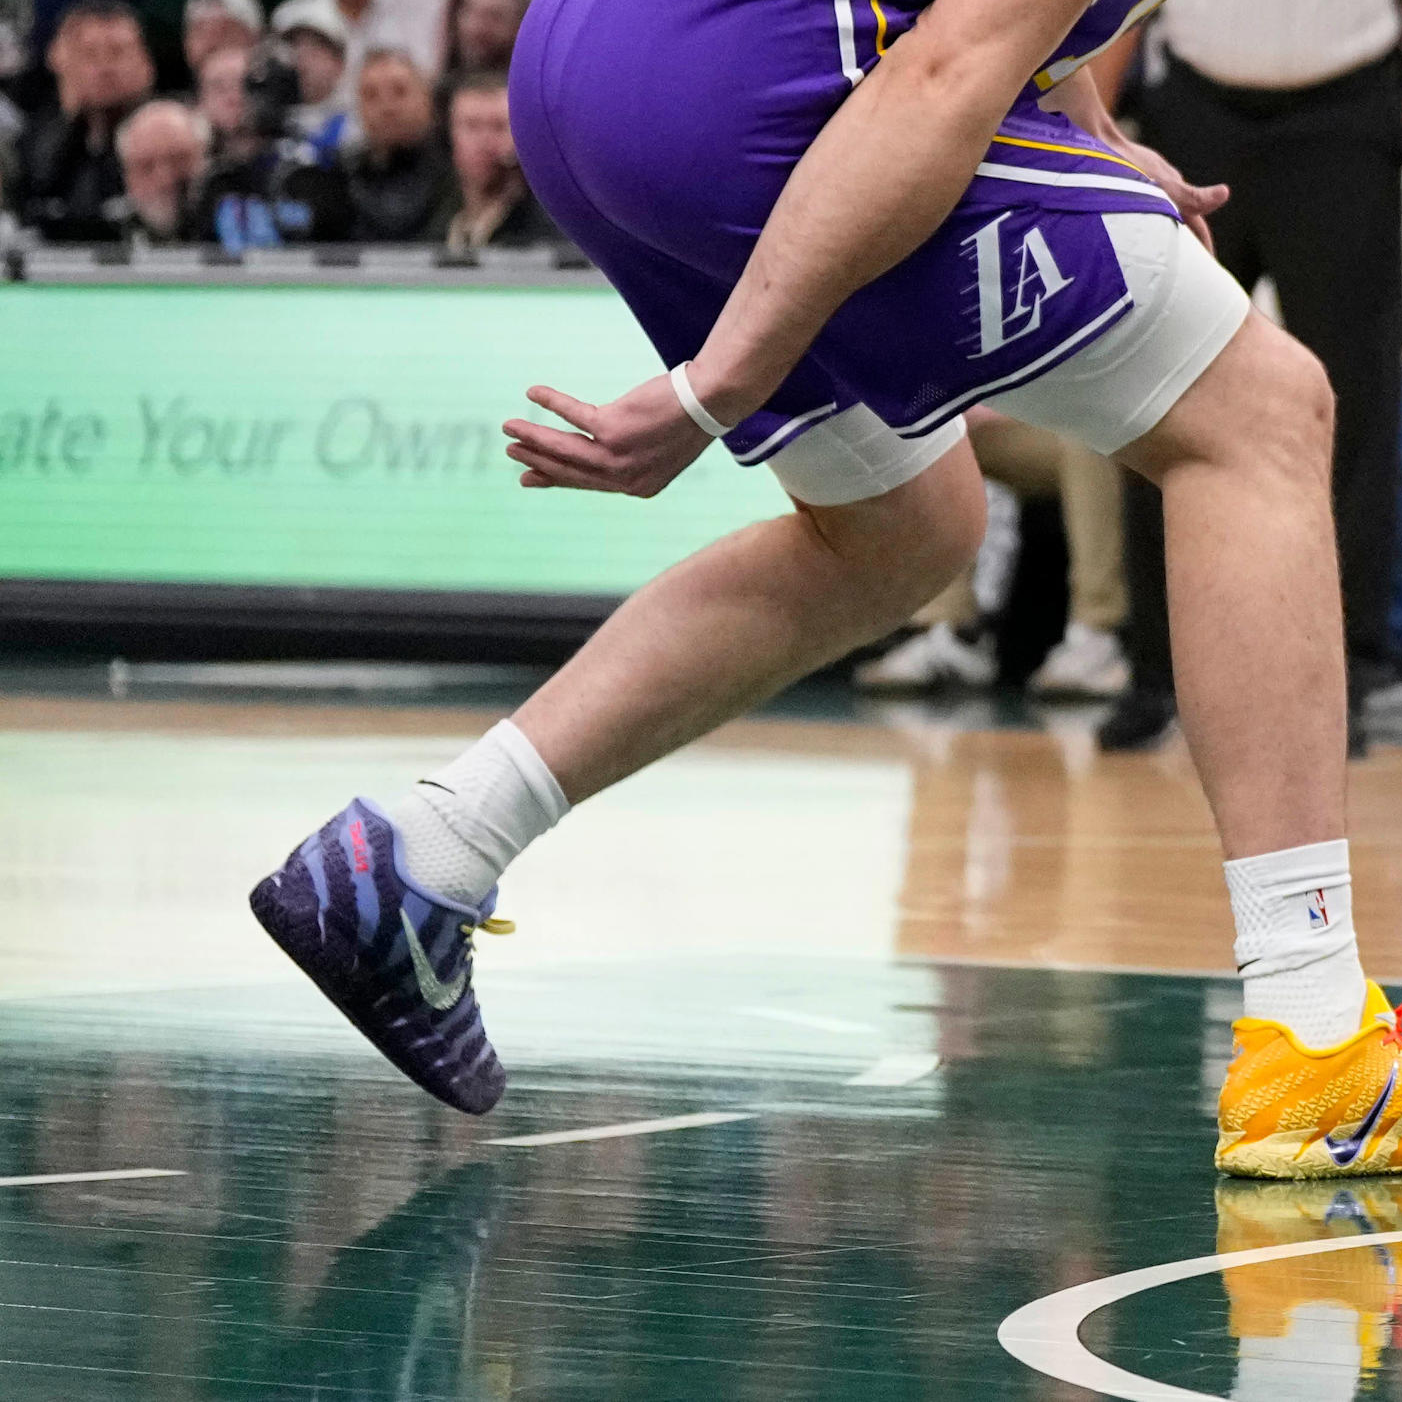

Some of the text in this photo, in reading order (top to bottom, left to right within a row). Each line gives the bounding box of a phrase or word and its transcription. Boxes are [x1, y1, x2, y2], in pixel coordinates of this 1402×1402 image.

[956, 210, 1075, 360] LA
[139, 394, 292, 476] Your
[316, 396, 493, 478] Own
